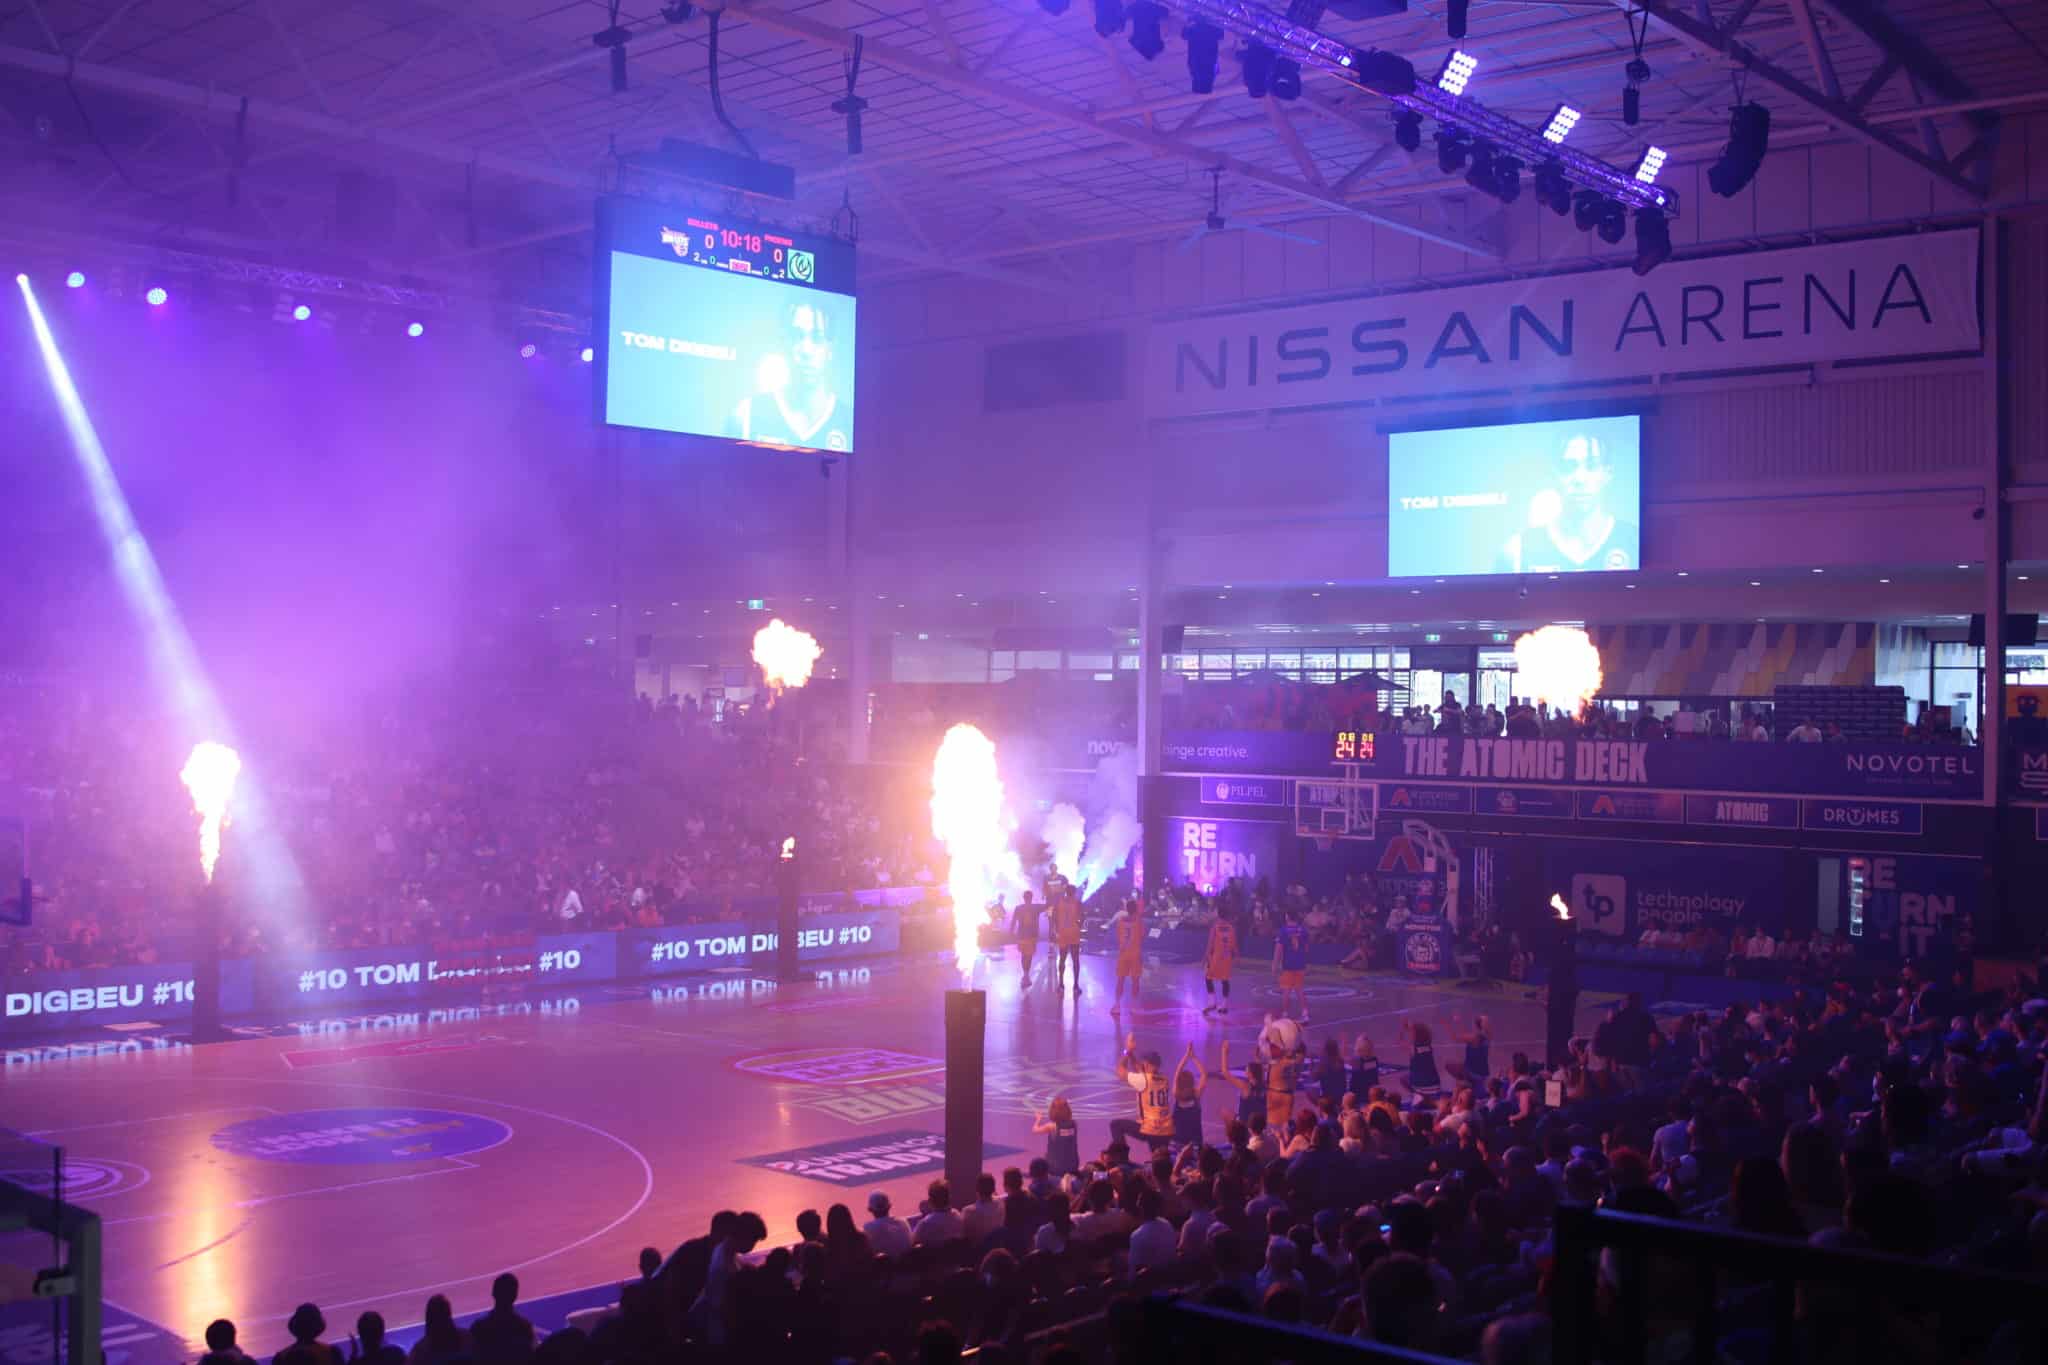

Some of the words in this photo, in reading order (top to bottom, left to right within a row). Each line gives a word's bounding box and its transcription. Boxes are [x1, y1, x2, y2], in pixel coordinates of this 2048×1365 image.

[704, 234, 715, 250] 0
[720, 229, 761, 254] 10:18
[773, 248, 783, 264] 0
[1176, 299, 1574, 393] NISSAN
[1616, 263, 1933, 351] ARENA
[1336, 741, 1355, 758] 24
[1360, 742, 1373, 759] 24
[1403, 737, 1448, 776] THE
[1459, 738, 1565, 781] ATOMIC
[1574, 740, 1649, 783] DECK
[1847, 753, 1975, 775] NOVOTEL
[1715, 801, 1769, 823] ATOMIC
[1183, 822, 1217, 849] RE
[1183, 849, 1256, 879] TURN
[1637, 888, 1745, 920] technology
[651, 940, 690, 961] #10
[695, 935, 746, 957] TOM
[752, 928, 833, 953] DIEU
[840, 925, 872, 944] #10
[539, 950, 581, 972] #10
[299, 969, 348, 992] #10
[353, 962, 419, 986] TOM
[5, 984, 144, 1016] DIGBEU
